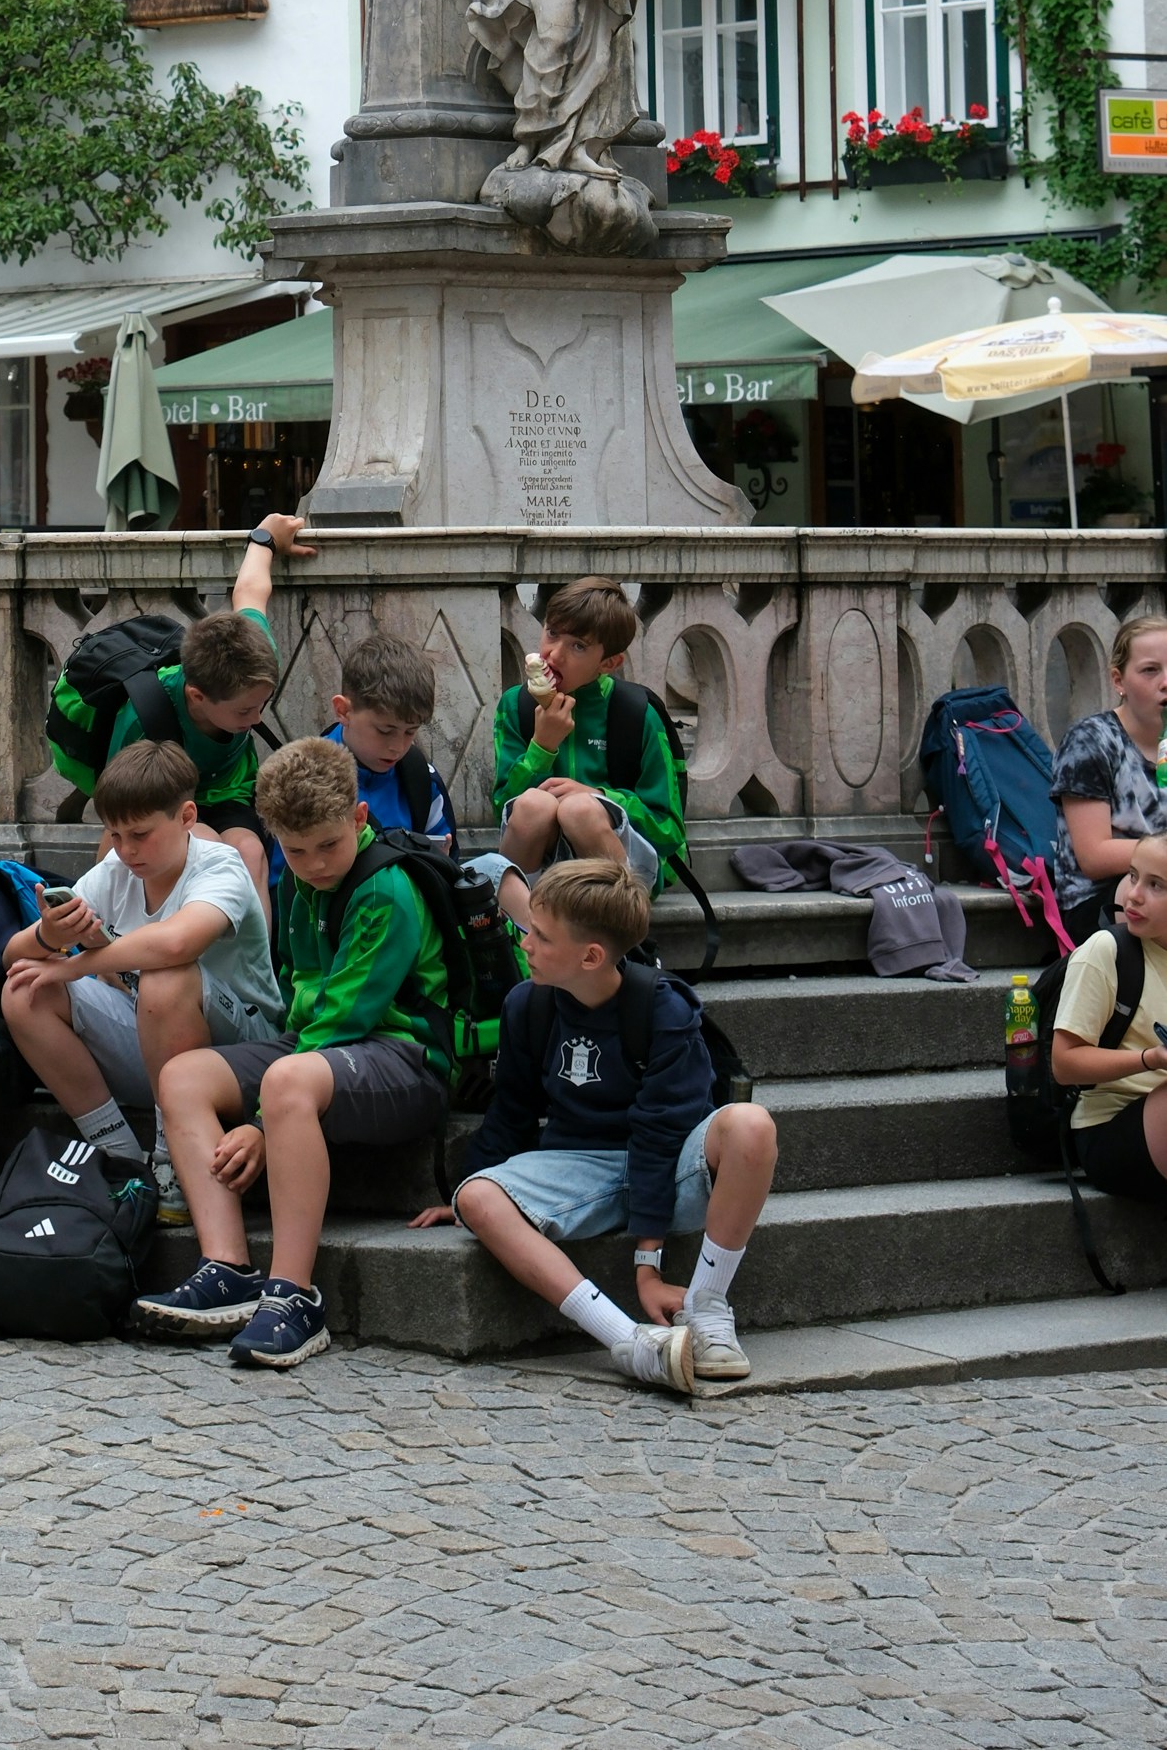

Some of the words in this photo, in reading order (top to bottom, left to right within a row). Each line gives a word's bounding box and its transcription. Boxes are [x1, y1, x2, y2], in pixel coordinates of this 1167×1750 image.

[724, 373, 773, 402] Bar
[162, 396, 198, 424] otel
[227, 395, 268, 422] Bar
[510, 426, 544, 436] TRINO
[519, 457, 538, 466] Filio
[547, 508, 572, 519] Matri
[883, 877, 924, 894] Ulri
[1014, 1012, 1031, 1024] day
[89, 1119, 126, 1141] adidas
